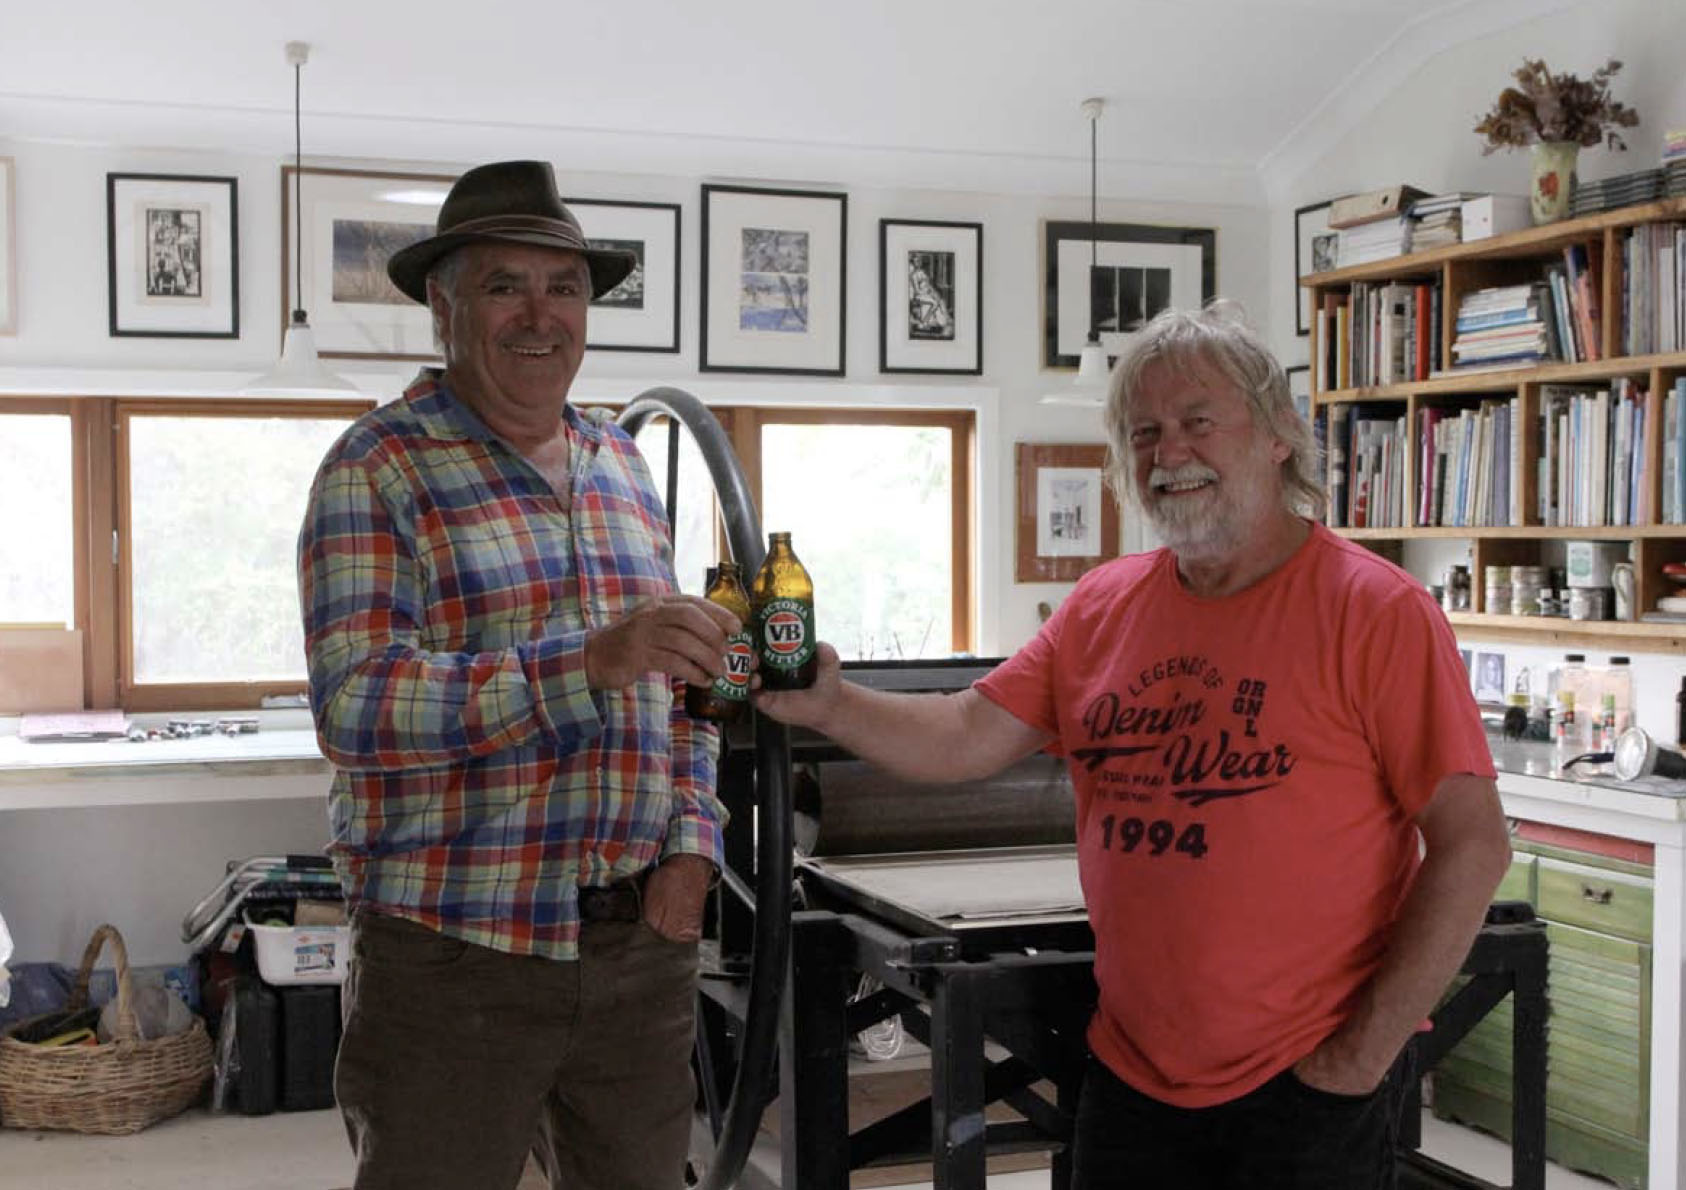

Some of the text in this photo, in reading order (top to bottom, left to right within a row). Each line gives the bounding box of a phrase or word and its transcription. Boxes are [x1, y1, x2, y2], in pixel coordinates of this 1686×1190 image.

[761, 600, 808, 619] VICTORIA
[768, 623, 801, 641] VB
[764, 647, 808, 664] BITTER
[1082, 691, 1206, 742] Denim
[1163, 730, 1297, 786] Wear
[1102, 814, 1208, 858] 1994
